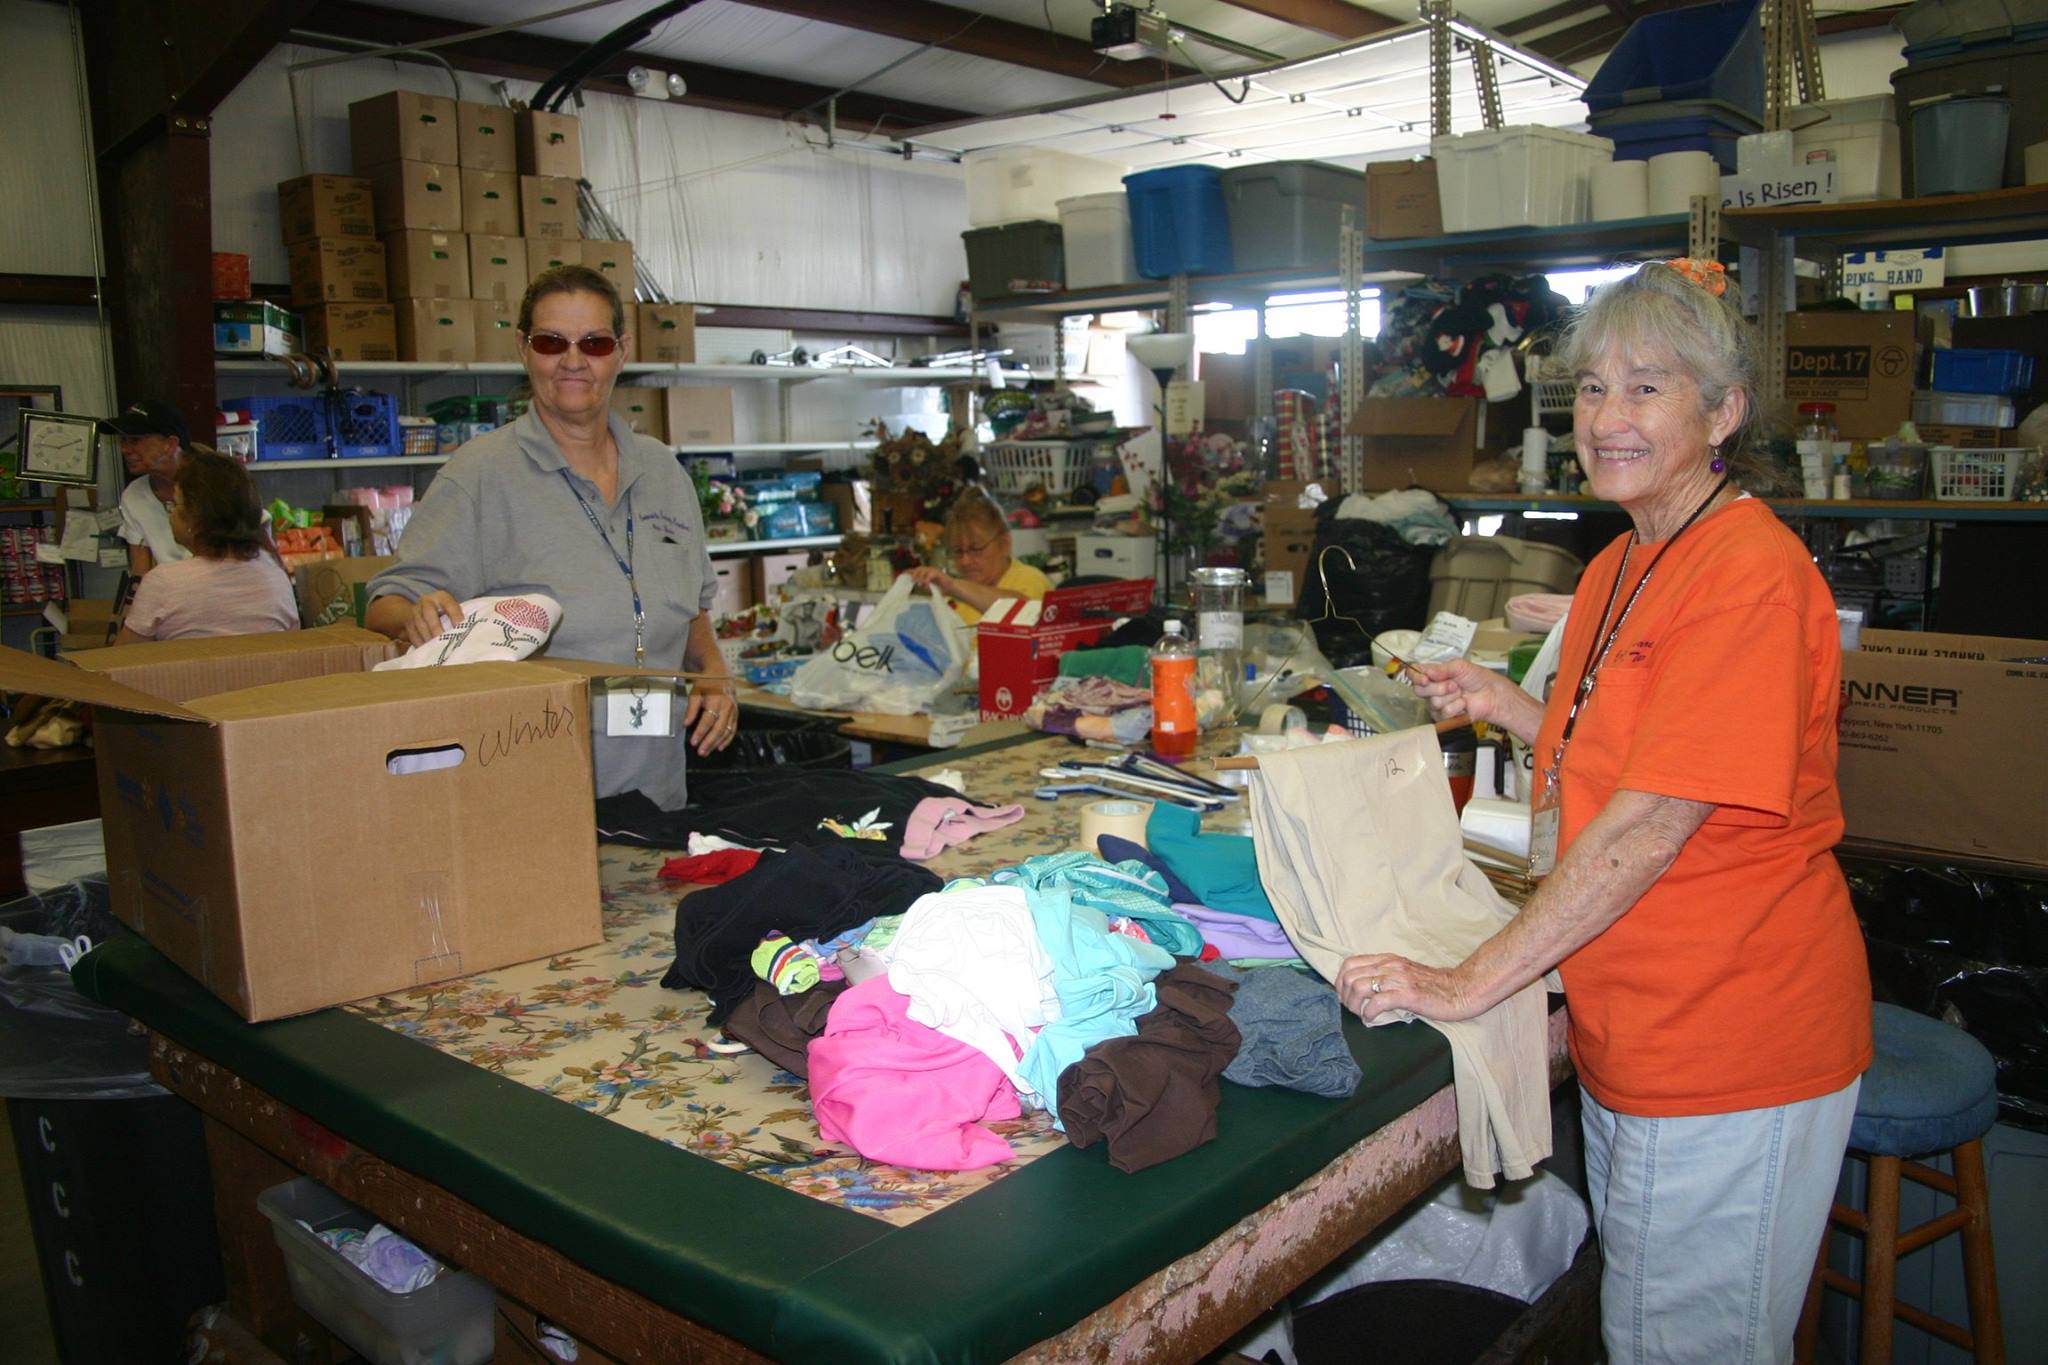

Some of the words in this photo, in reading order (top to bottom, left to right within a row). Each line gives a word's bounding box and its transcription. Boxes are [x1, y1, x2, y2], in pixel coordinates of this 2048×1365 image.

[1721, 199, 1733, 210] e
[1738, 190, 1755, 209] Is
[1761, 180, 1818, 204] Risen
[1845, 270, 1876, 287] PING
[1887, 267, 1923, 285] HAND
[832, 639, 895, 674] belk
[1840, 679, 1958, 708] NNER
[982, 709, 1026, 721] BACARD
[478, 697, 575, 768] Winter
[1384, 758, 1405, 779] 12
